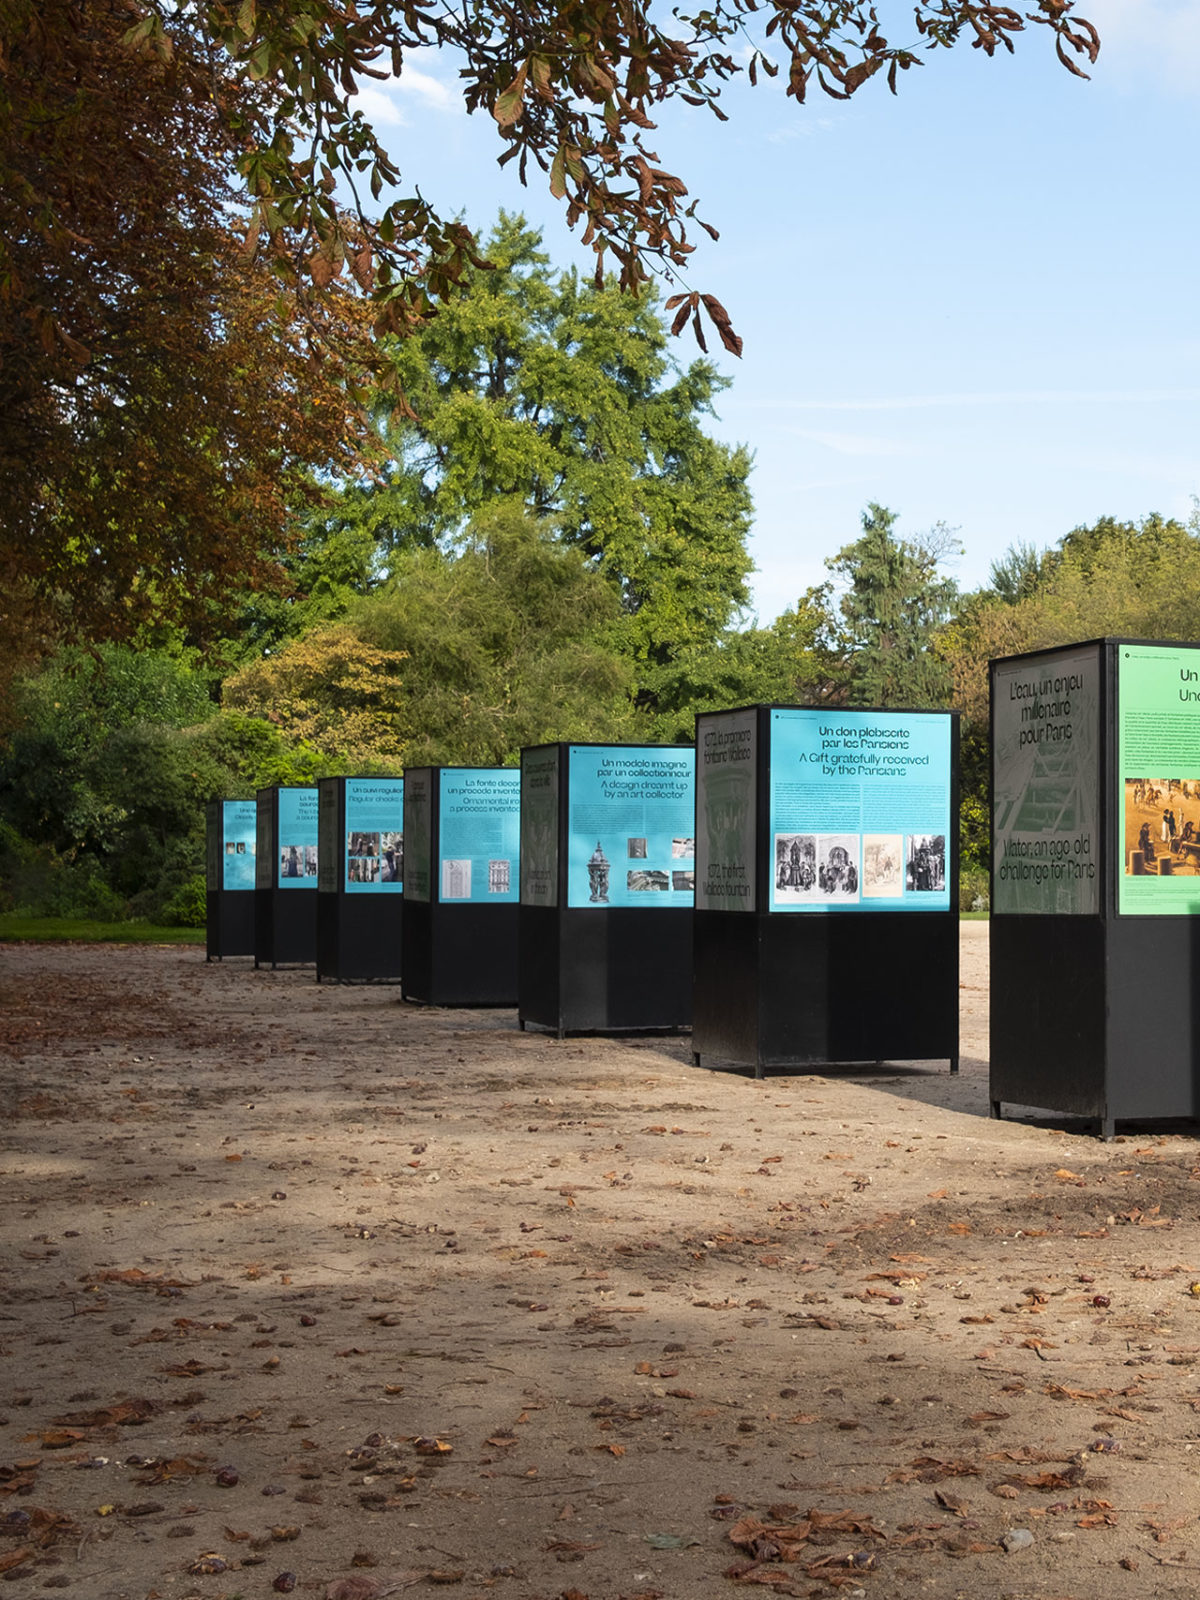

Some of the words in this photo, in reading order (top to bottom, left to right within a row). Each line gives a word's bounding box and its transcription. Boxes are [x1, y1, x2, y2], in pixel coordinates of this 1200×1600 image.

[1180, 669, 1198, 682] Un
[1039, 677, 1052, 696] un
[1054, 673, 1083, 697] enjeu
[819, 726, 834, 737] Un
[835, 726, 857, 737] don
[1019, 728, 1044, 750] pour
[1046, 723, 1073, 742] Paris
[822, 739, 842, 750] par
[843, 738, 860, 749] les
[860, 739, 910, 750] Parisiens
[602, 759, 615, 768] Un
[799, 753, 808, 763] A
[809, 752, 829, 763] Gift
[830, 753, 881, 766] gratefully
[882, 754, 929, 765] received
[597, 769, 612, 778] par
[822, 765, 836, 777] by
[838, 764, 856, 775] the
[857, 765, 907, 776] Parisians
[601, 780, 608, 788] A
[609, 780, 639, 790] design
[641, 780, 675, 789] dreamt
[676, 782, 688, 791] up
[604, 790, 616, 800] by
[617, 791, 628, 799] an
[630, 790, 644, 799] art
[645, 790, 685, 799] collector
[1034, 839, 1048, 857] an
[999, 862, 1049, 885] challenge
[1051, 860, 1066, 879] for
[1068, 860, 1095, 879] Paris
